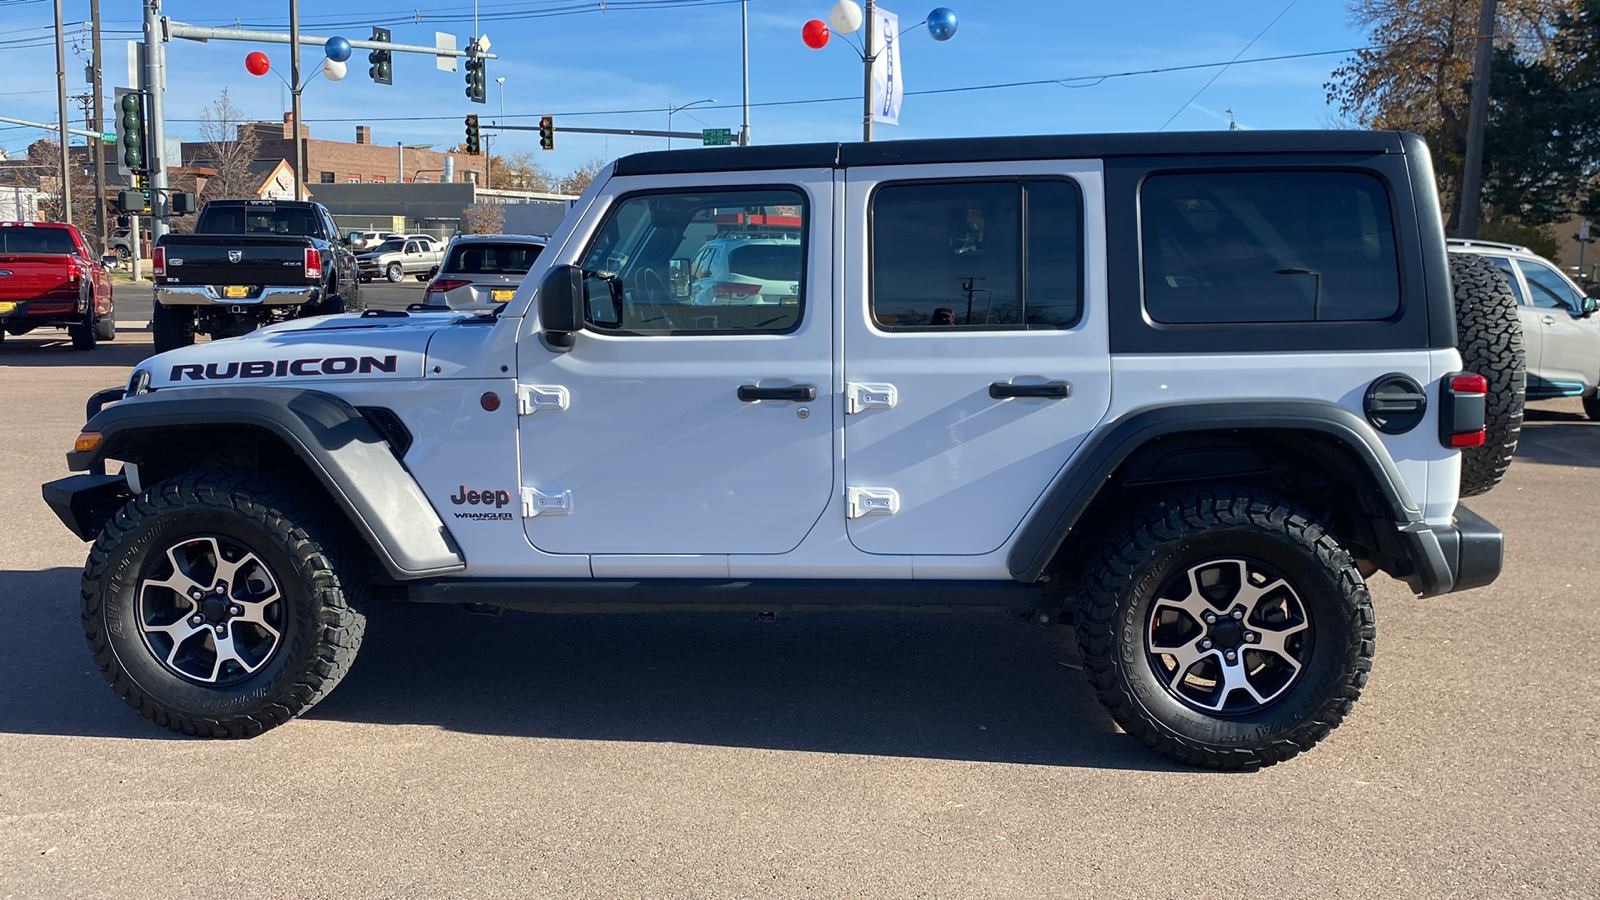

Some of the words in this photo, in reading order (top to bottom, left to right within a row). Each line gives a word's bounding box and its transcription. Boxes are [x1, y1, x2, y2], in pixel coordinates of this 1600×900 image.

[885, 81, 893, 113] EVENT
[169, 355, 398, 381] RUBICON
[450, 484, 511, 509] Jeep
[1122, 544, 1190, 701] BFGoodrich
